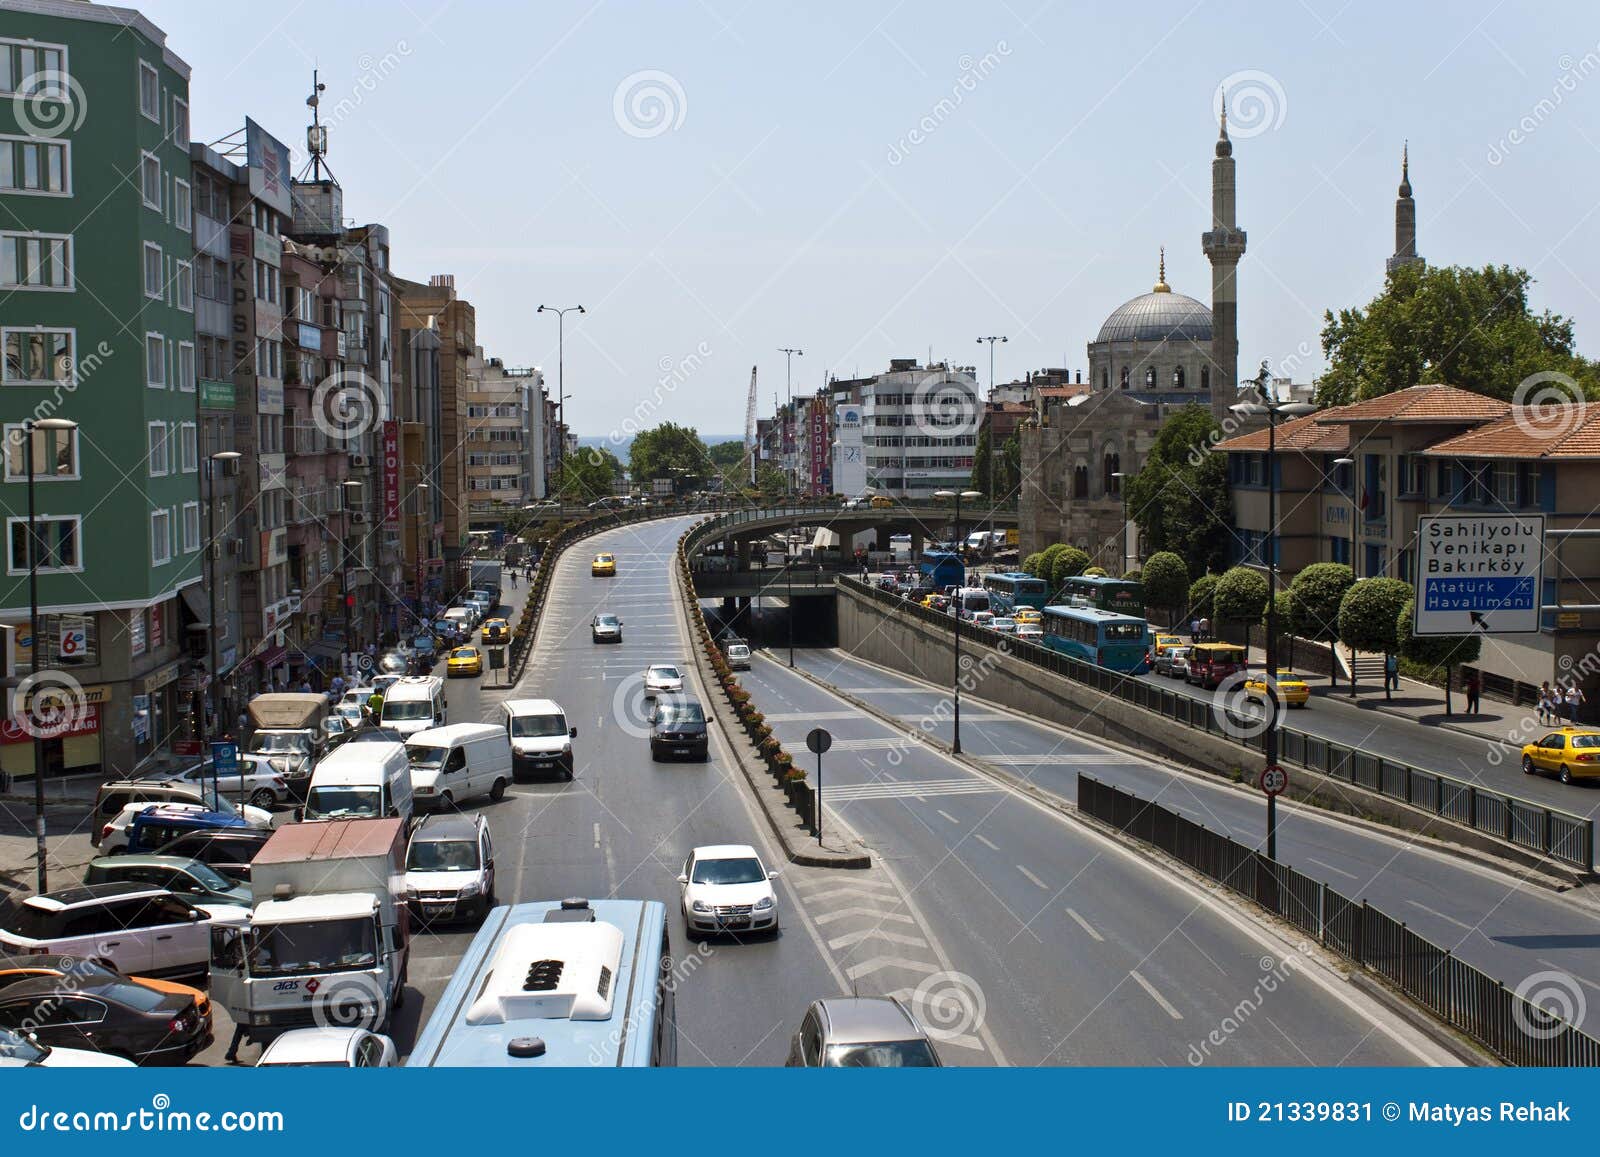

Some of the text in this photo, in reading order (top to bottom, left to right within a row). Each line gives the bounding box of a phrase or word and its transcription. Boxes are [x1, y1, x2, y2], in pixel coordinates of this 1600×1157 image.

[386, 440, 397, 518] HOTEL
[1430, 522, 1534, 540] Sahilyolu
[1429, 541, 1525, 557] Yenikapı
[1428, 558, 1524, 575] Bakırköy
[1428, 581, 1495, 593] Atatürk
[1429, 596, 1530, 608] Havalimanı
[63, 631, 77, 654] 6
[273, 980, 300, 991] aras
